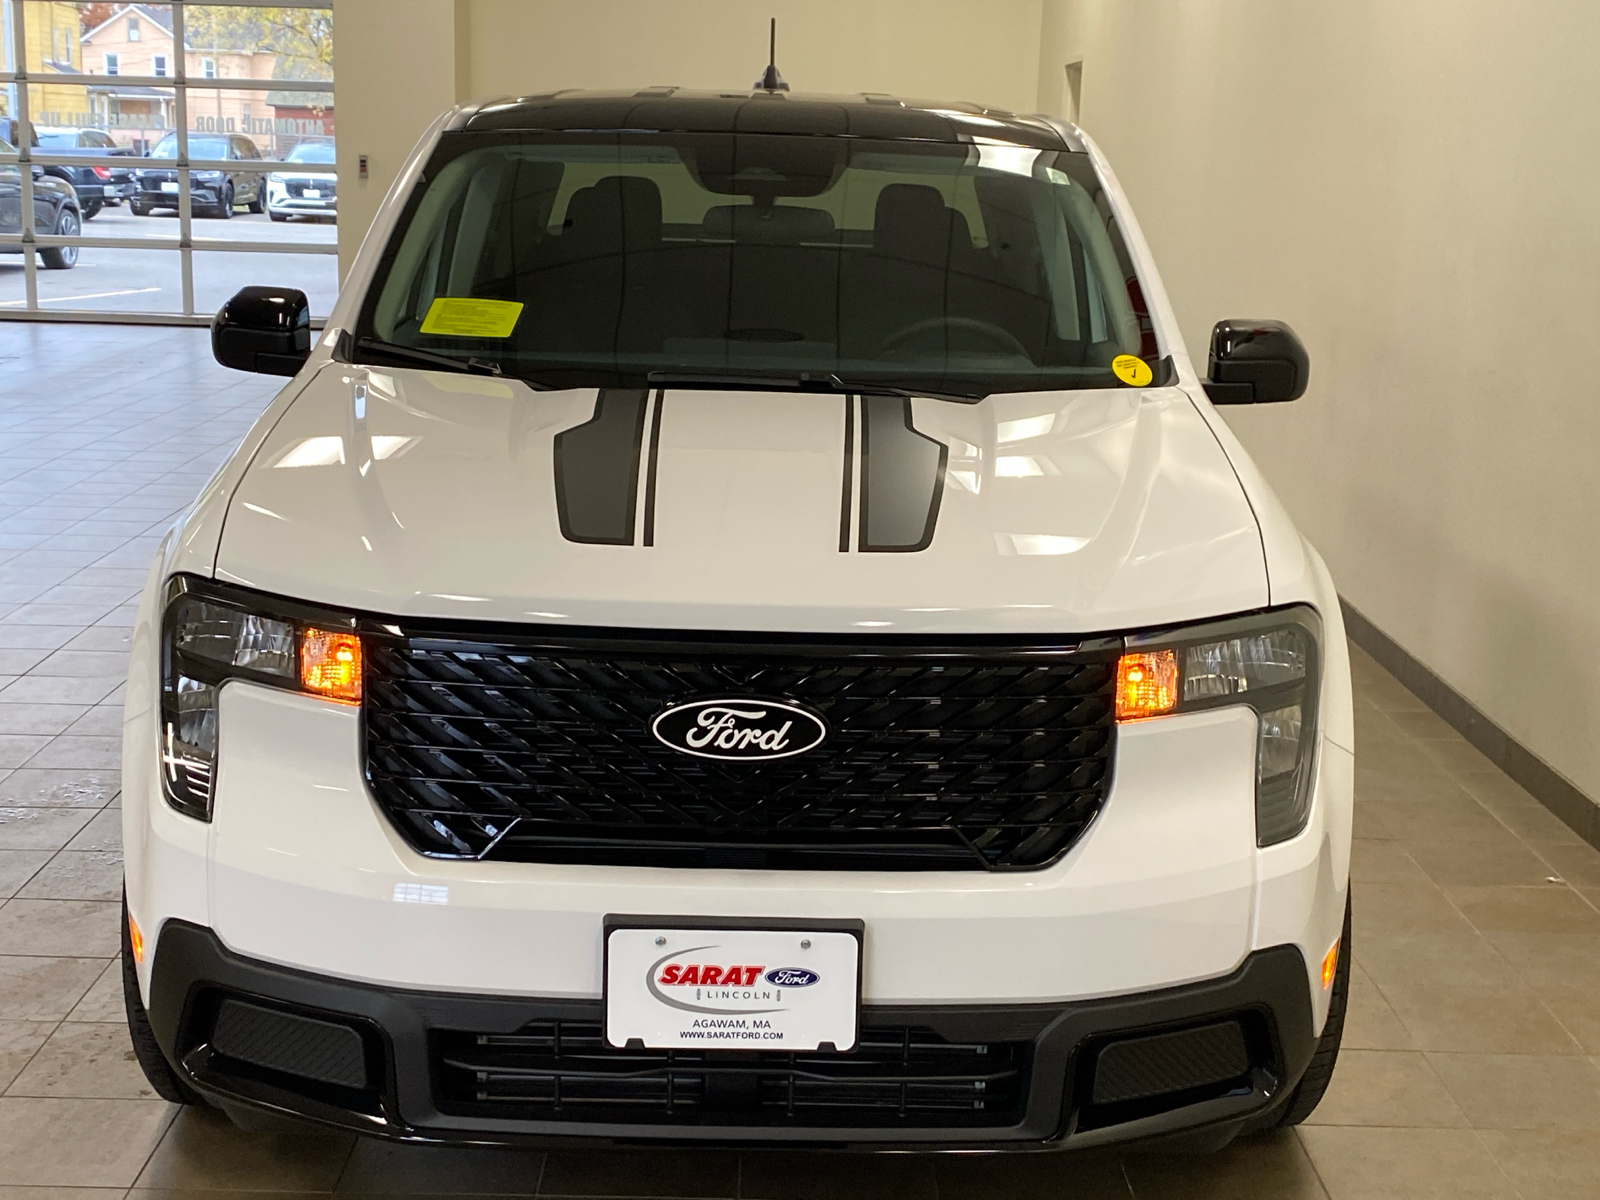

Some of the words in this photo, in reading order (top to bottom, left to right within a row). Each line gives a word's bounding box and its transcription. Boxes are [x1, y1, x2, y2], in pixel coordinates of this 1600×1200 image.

[686, 707, 793, 751] Ford
[658, 963, 766, 987] SARAT
[774, 970, 809, 986] Ford
[707, 991, 770, 1000] LINCOLN
[692, 1019, 749, 1030] AGAWAM,
[753, 1021, 771, 1029] MA
[680, 1031, 784, 1040] WWW.SARATFORD.COM
